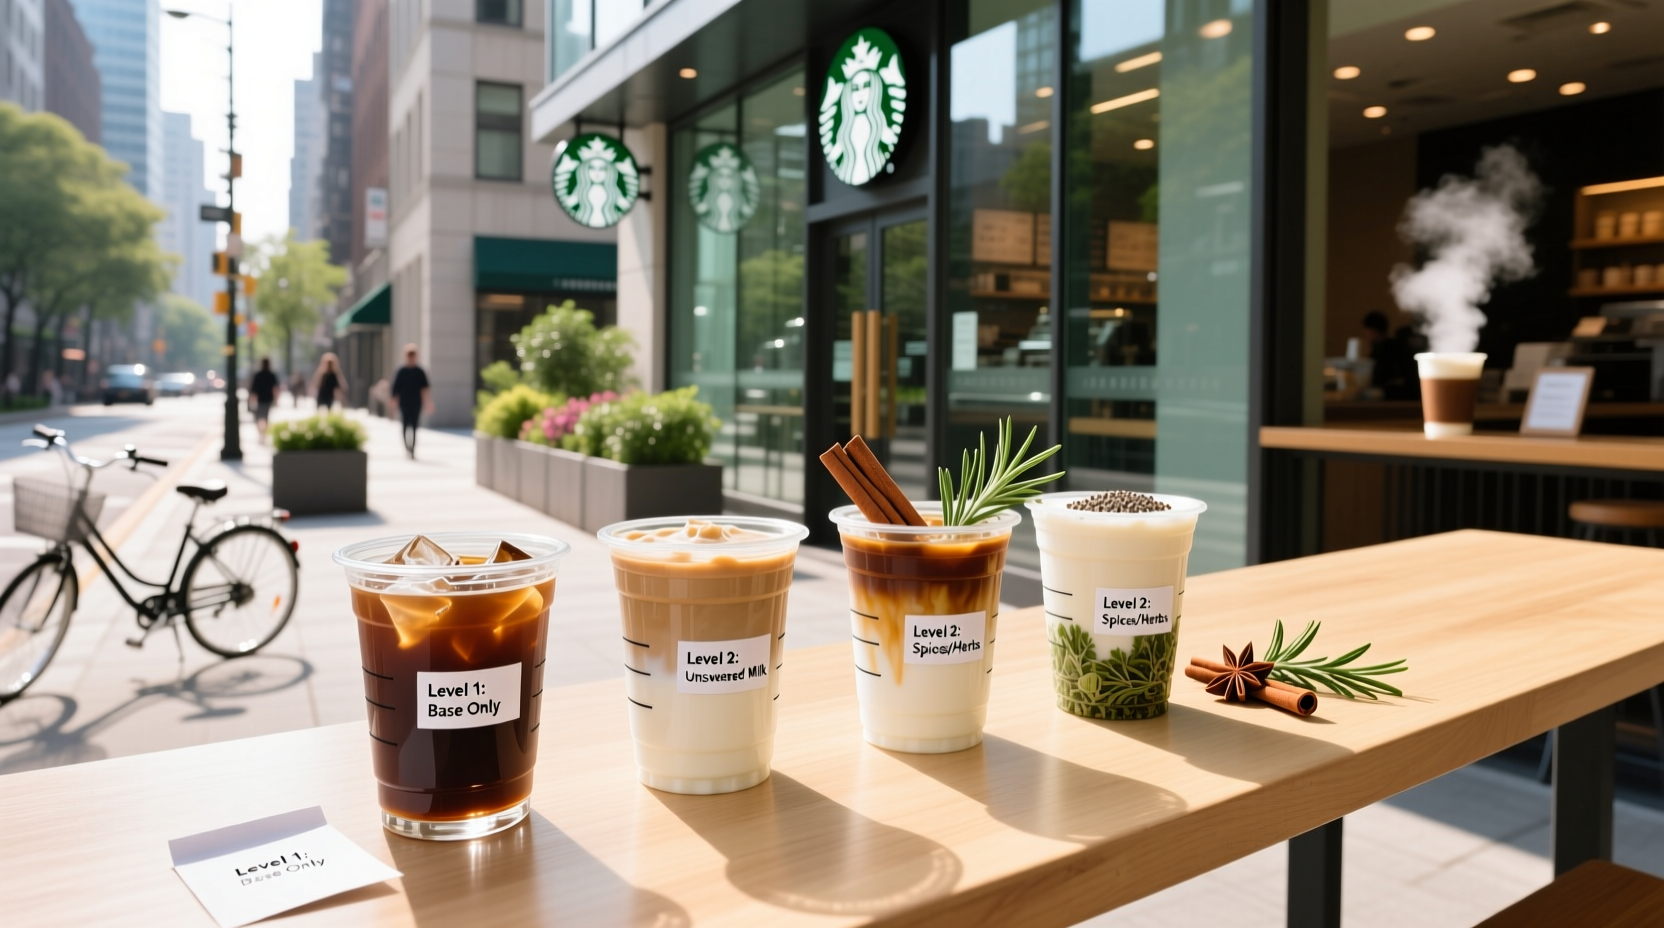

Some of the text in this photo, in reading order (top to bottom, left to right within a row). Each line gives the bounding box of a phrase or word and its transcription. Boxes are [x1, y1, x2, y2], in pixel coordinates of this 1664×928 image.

[1103, 596, 1151, 609] Level 2:
[913, 624, 961, 638] Level 2:
[687, 651, 739, 665] Level 2:
[748, 663, 767, 679] Milk
[428, 681, 486, 697] Level 1:
[428, 699, 501, 717] Base Only
[235, 852, 308, 876] Level 1:
[286, 858, 325, 873] Only
